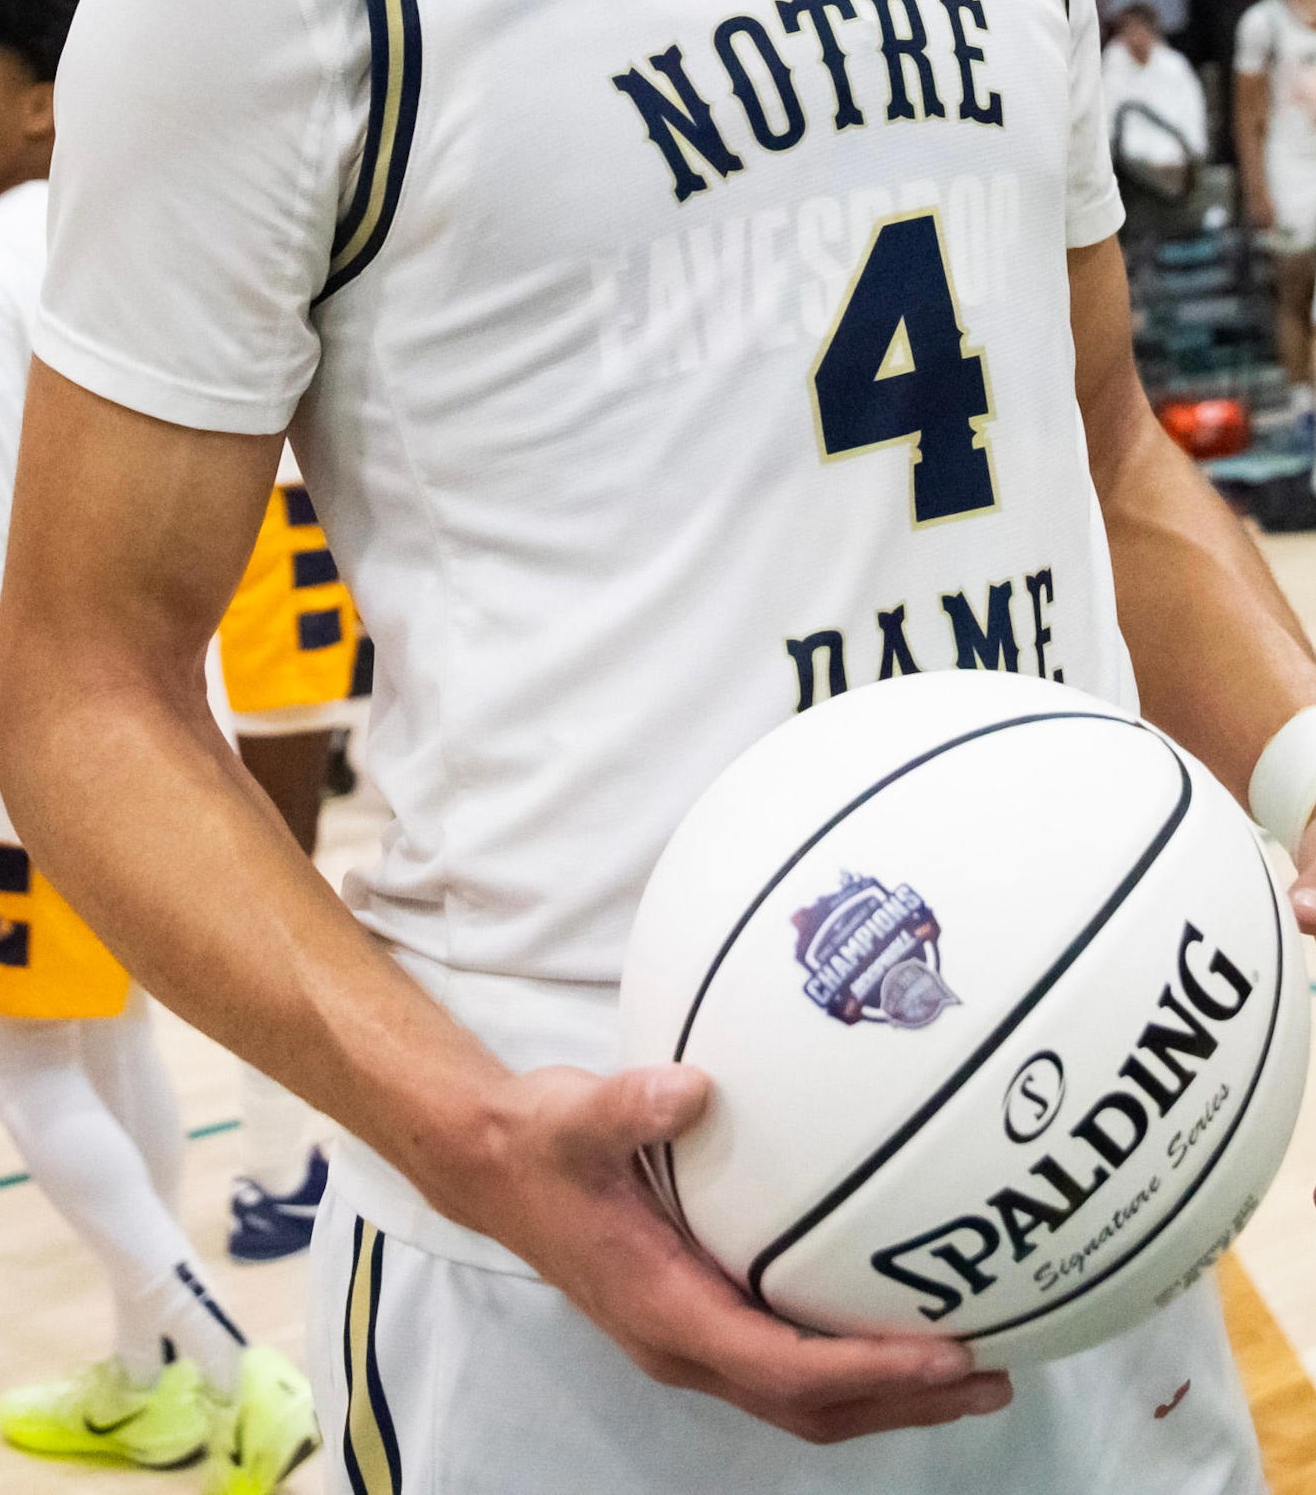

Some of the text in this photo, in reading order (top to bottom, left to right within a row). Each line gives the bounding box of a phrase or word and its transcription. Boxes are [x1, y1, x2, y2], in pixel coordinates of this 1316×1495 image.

[807, 205, 1002, 532] 4
[805, 884, 922, 1007] CHAMPIONS
[870, 919, 1254, 1322] SPALDING
[1032, 1176, 1161, 1292] Signature
[1166, 1083, 1230, 1169] Series
